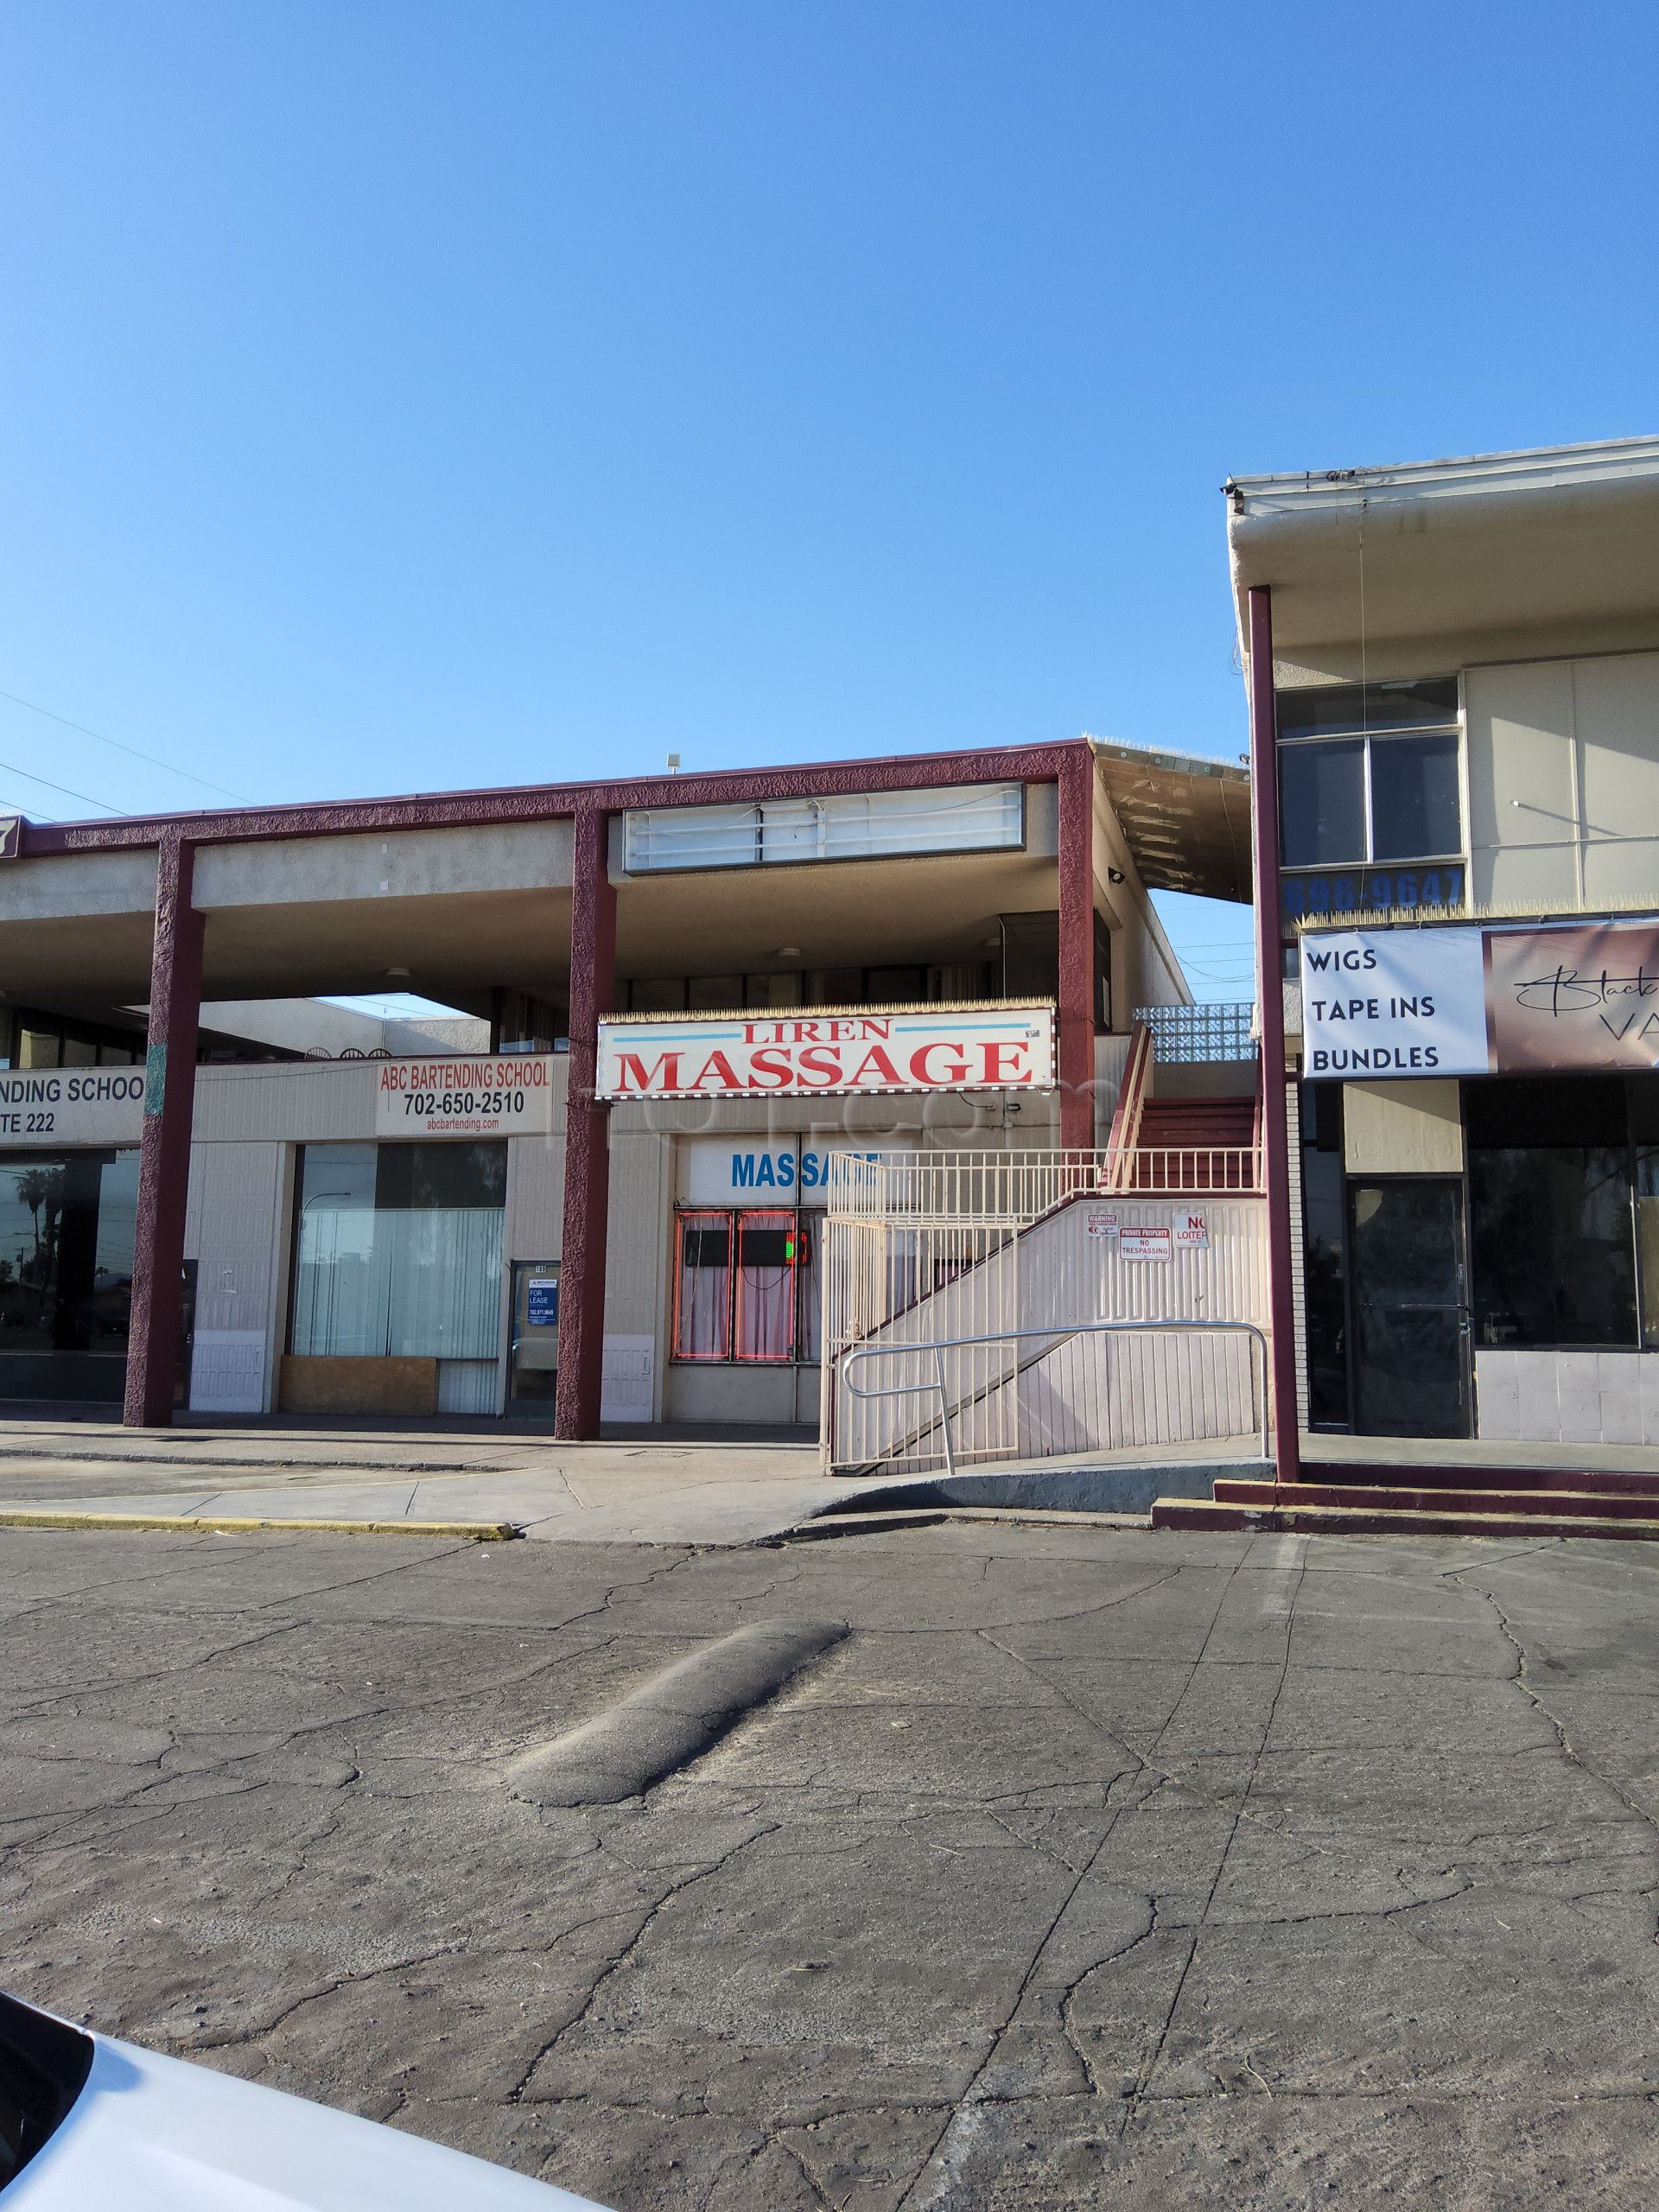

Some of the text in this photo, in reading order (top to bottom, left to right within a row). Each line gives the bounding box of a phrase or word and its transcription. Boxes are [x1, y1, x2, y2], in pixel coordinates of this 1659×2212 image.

[1306, 949, 1377, 972] WIGS
[1514, 964, 1658, 1017] Black
[1312, 996, 1435, 1021] TAPE INS
[741, 1019, 894, 1044] LIREN
[613, 1042, 1033, 1092] MASSAGE
[1313, 1046, 1439, 1071] BUNDLES
[380, 1061, 550, 1090] ABC BARTENDING SCHOOL
[404, 1090, 524, 1115] 702-650-2510
[26, 1112, 54, 1133] 222
[427, 1117, 499, 1132] abcbartending.com
